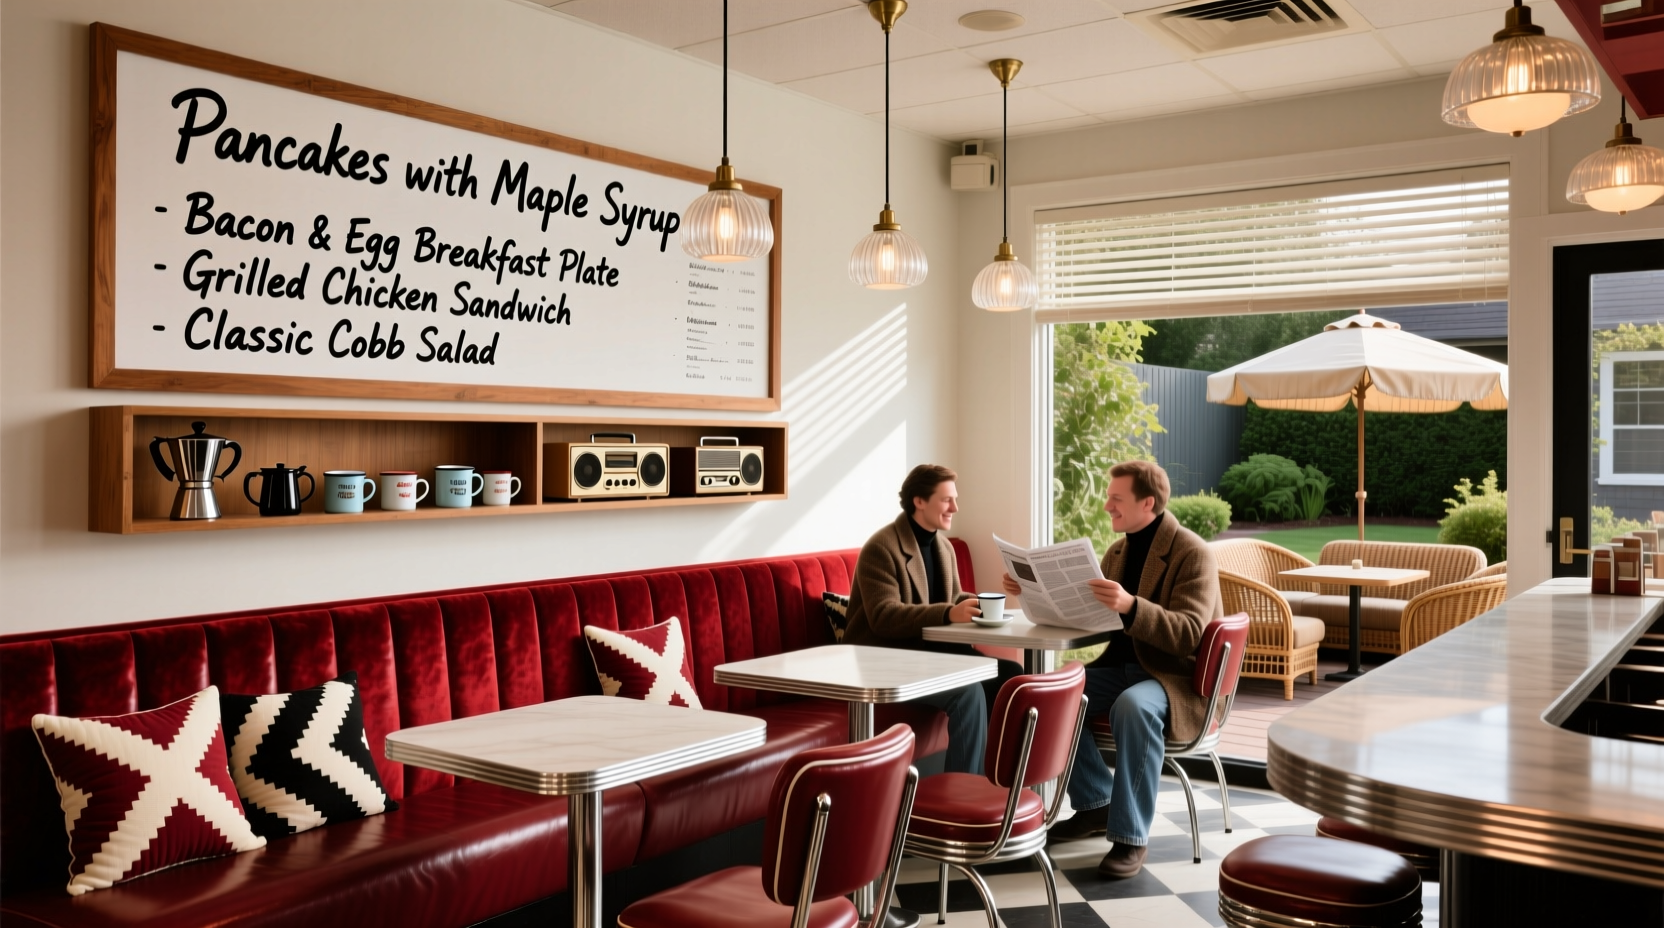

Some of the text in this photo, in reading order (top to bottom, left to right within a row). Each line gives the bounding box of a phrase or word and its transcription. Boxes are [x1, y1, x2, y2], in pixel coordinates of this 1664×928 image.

[171, 87, 681, 253] Pancakes with Maple Syrup
[184, 191, 295, 246] Bacon
[308, 214, 331, 252] &
[345, 217, 401, 274] Egg
[413, 226, 551, 286] Breakfast
[559, 248, 619, 288] Plate
[182, 248, 311, 300] Grilled
[322, 266, 438, 313] Chicken
[449, 280, 571, 326] Sandwich
[184, 306, 314, 356] Classic
[328, 318, 406, 360] Cobb
[415, 325, 500, 366] Salad
